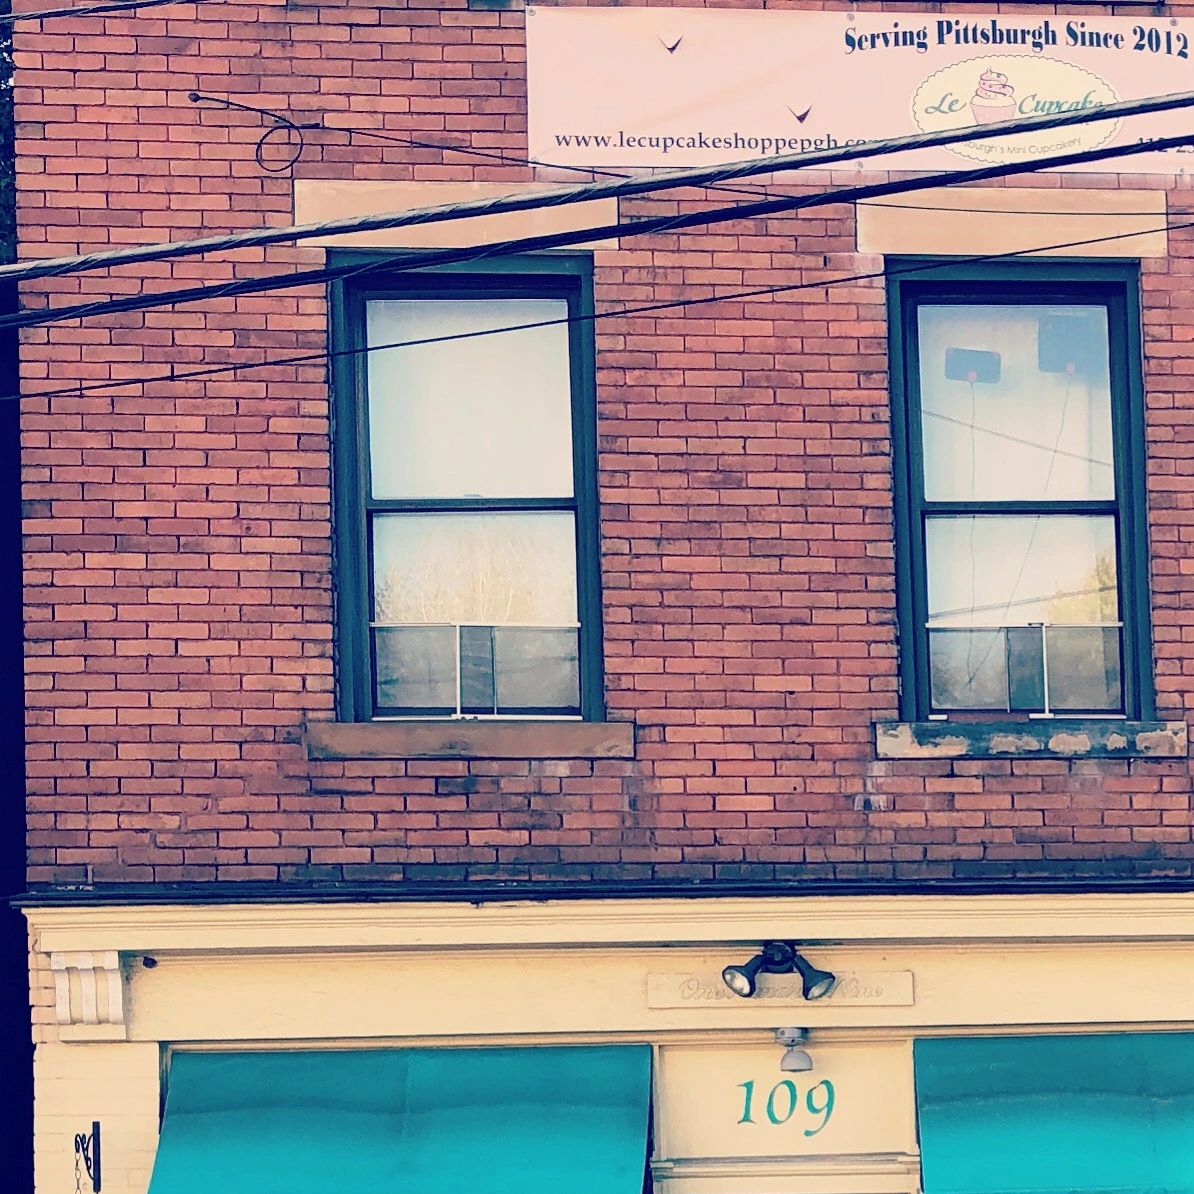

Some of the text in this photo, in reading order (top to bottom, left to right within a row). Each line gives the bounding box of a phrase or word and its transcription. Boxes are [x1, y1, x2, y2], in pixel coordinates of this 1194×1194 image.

[844, 19, 1188, 60] Serving Pittsburgh Since 2012
[924, 92, 967, 115] Le
[554, 130, 882, 154] www.lecupcakeshoppepghco
[737, 1078, 836, 1137] 109
